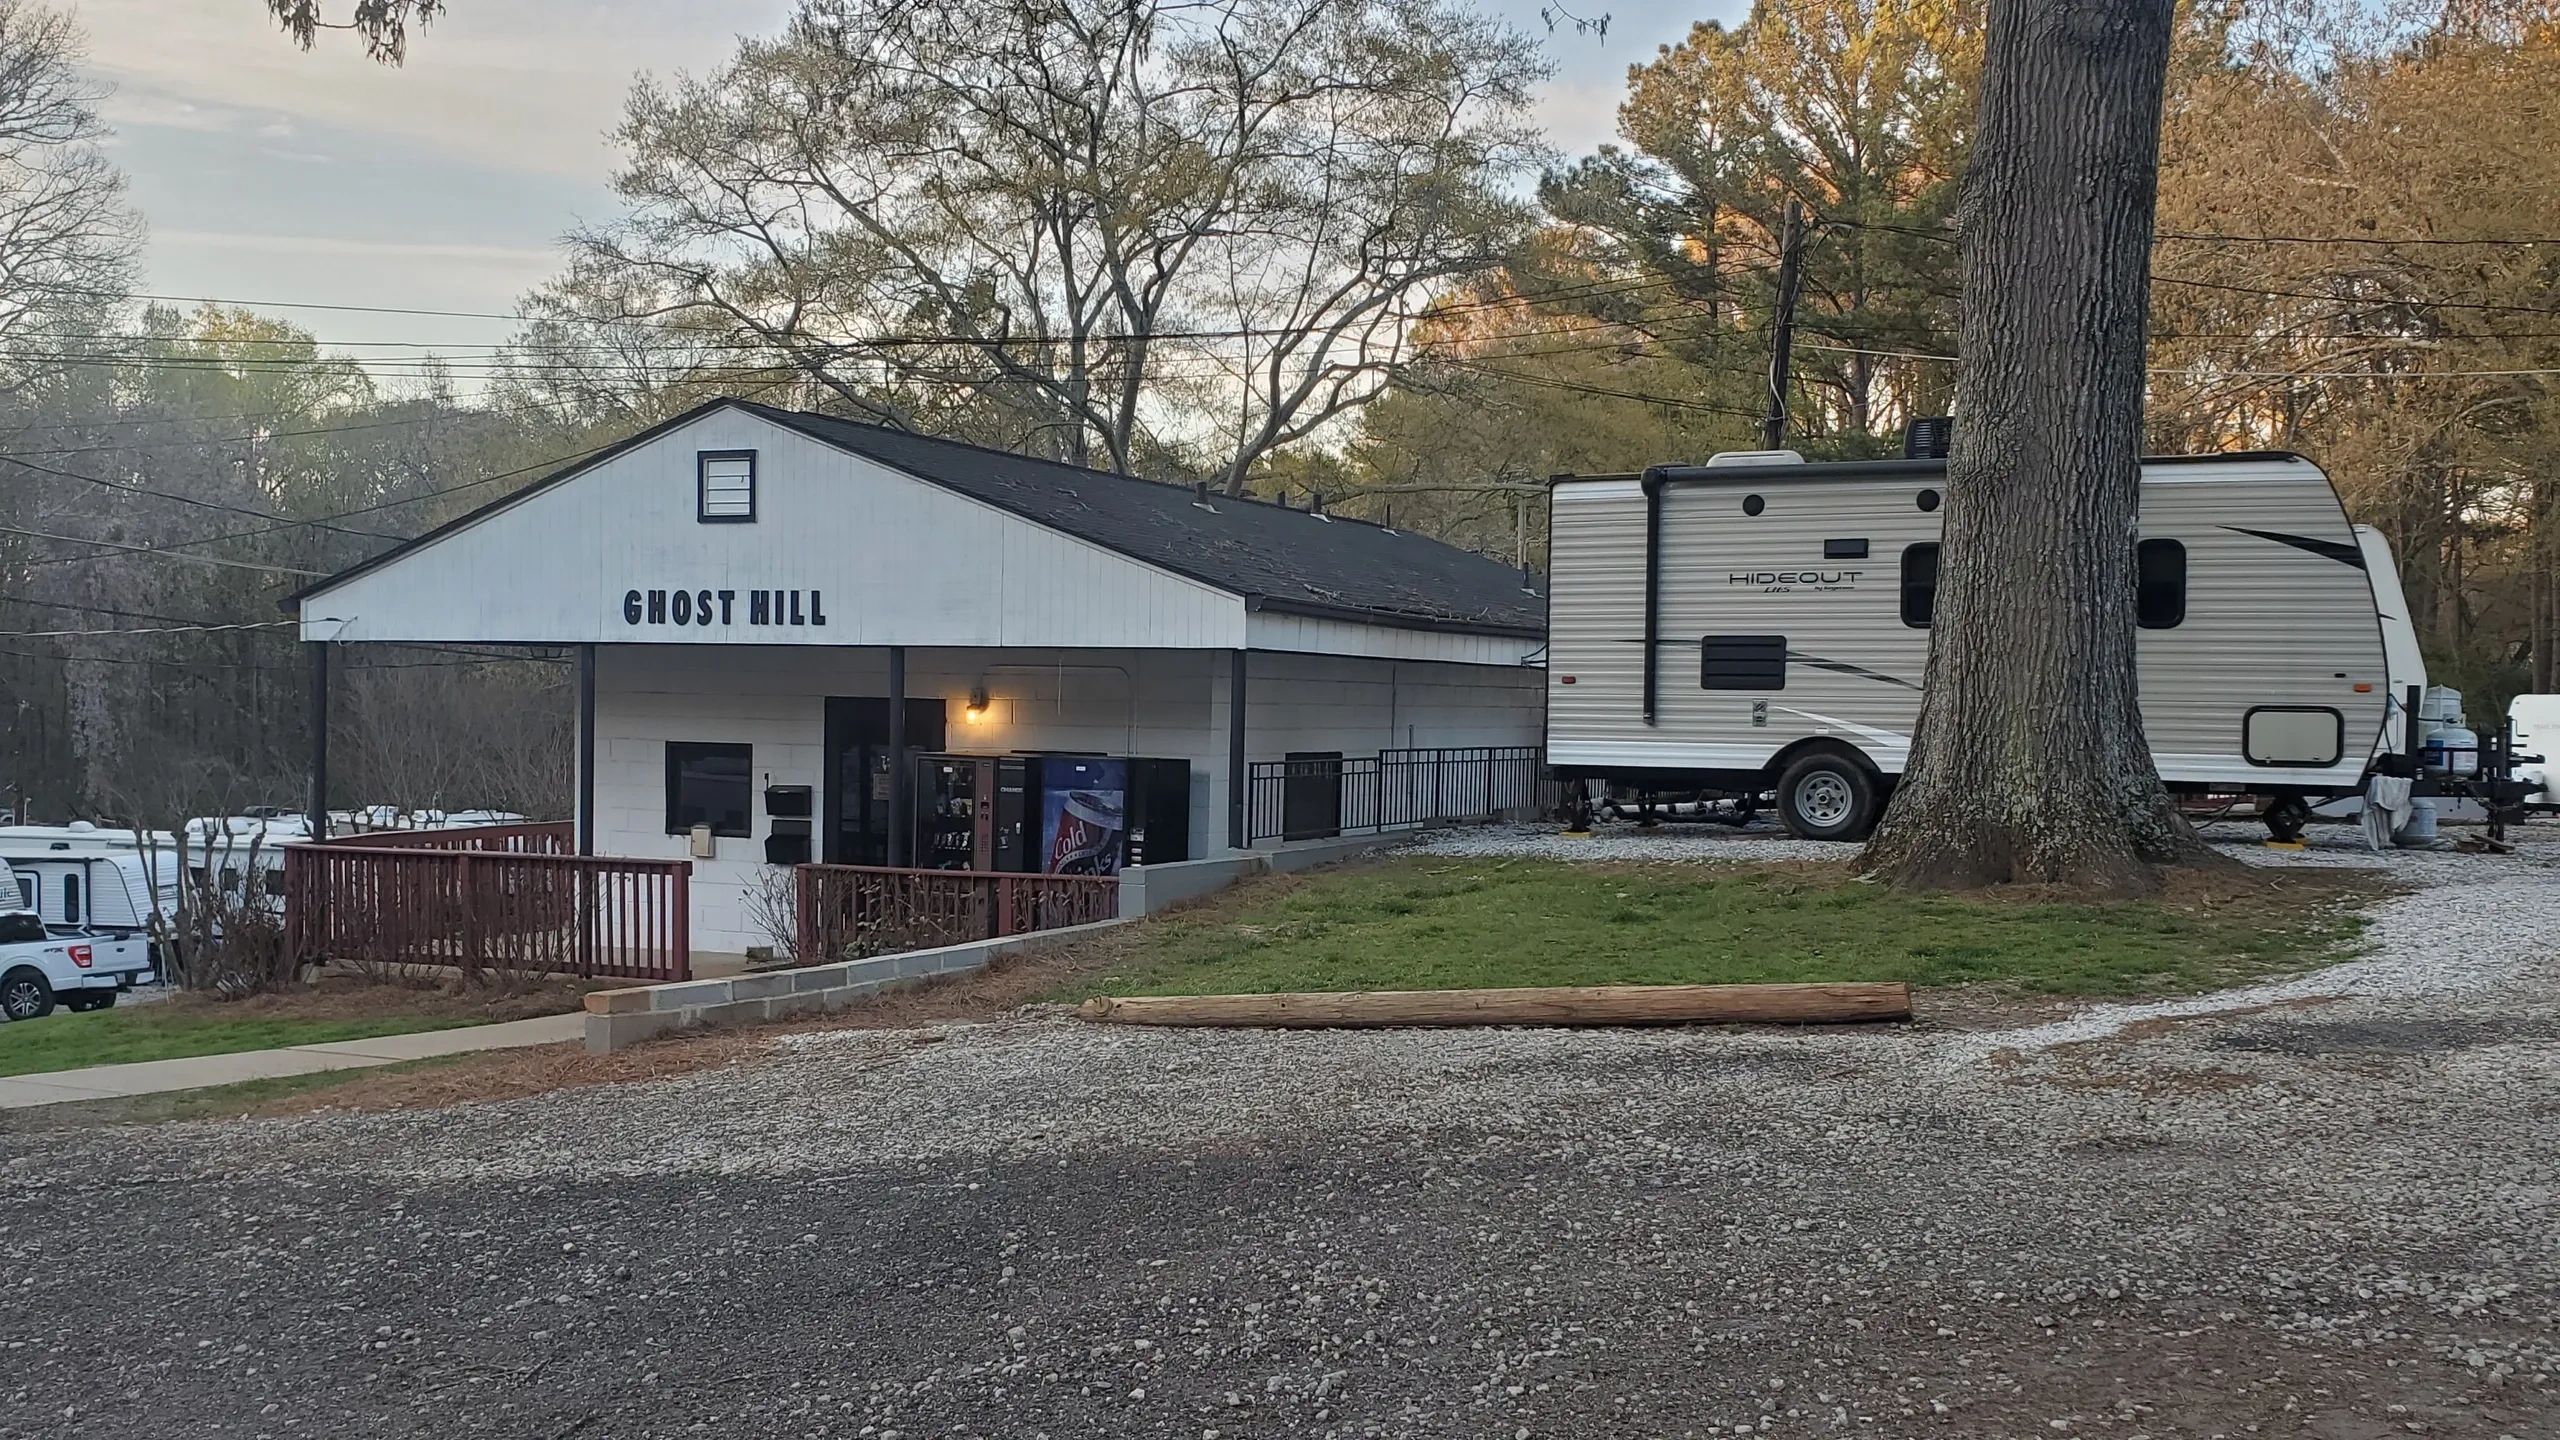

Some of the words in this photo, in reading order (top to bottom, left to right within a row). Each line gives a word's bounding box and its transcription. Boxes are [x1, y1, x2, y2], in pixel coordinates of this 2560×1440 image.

[1729, 572, 1863, 585] HIDEOUT
[623, 589, 735, 626] GHOST
[750, 589, 826, 626] HILL
[1055, 820, 1088, 860] Cold
